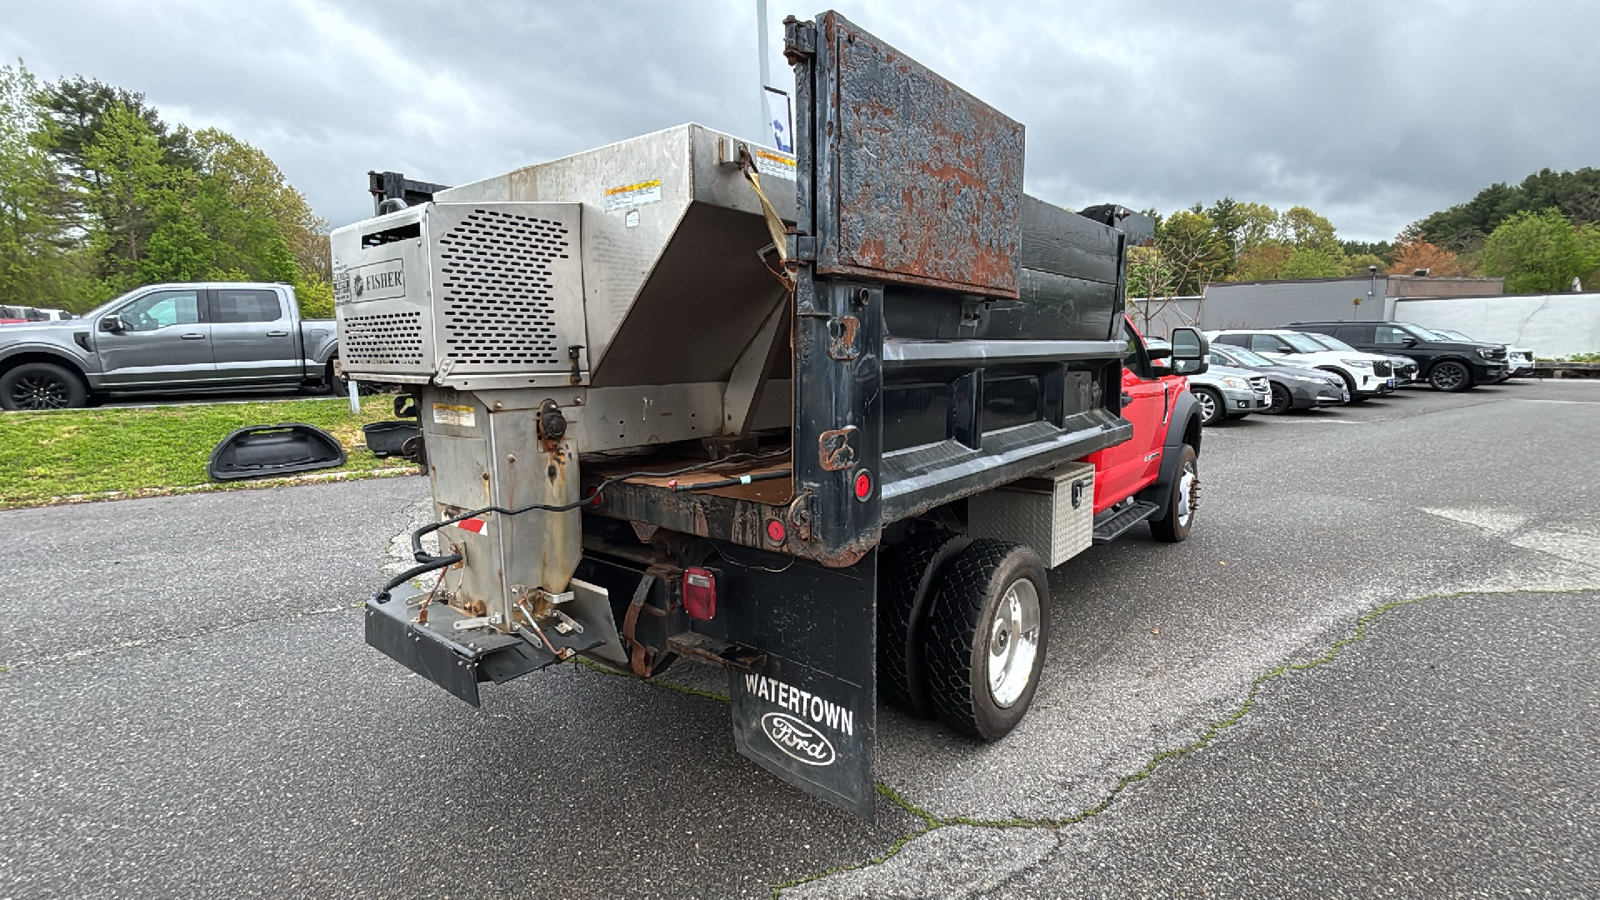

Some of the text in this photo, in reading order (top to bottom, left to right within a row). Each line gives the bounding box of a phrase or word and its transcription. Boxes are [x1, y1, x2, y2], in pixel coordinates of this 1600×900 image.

[366, 270, 403, 291] FISHER
[745, 673, 853, 736] WATERTOWN
[772, 717, 827, 759] Ford
